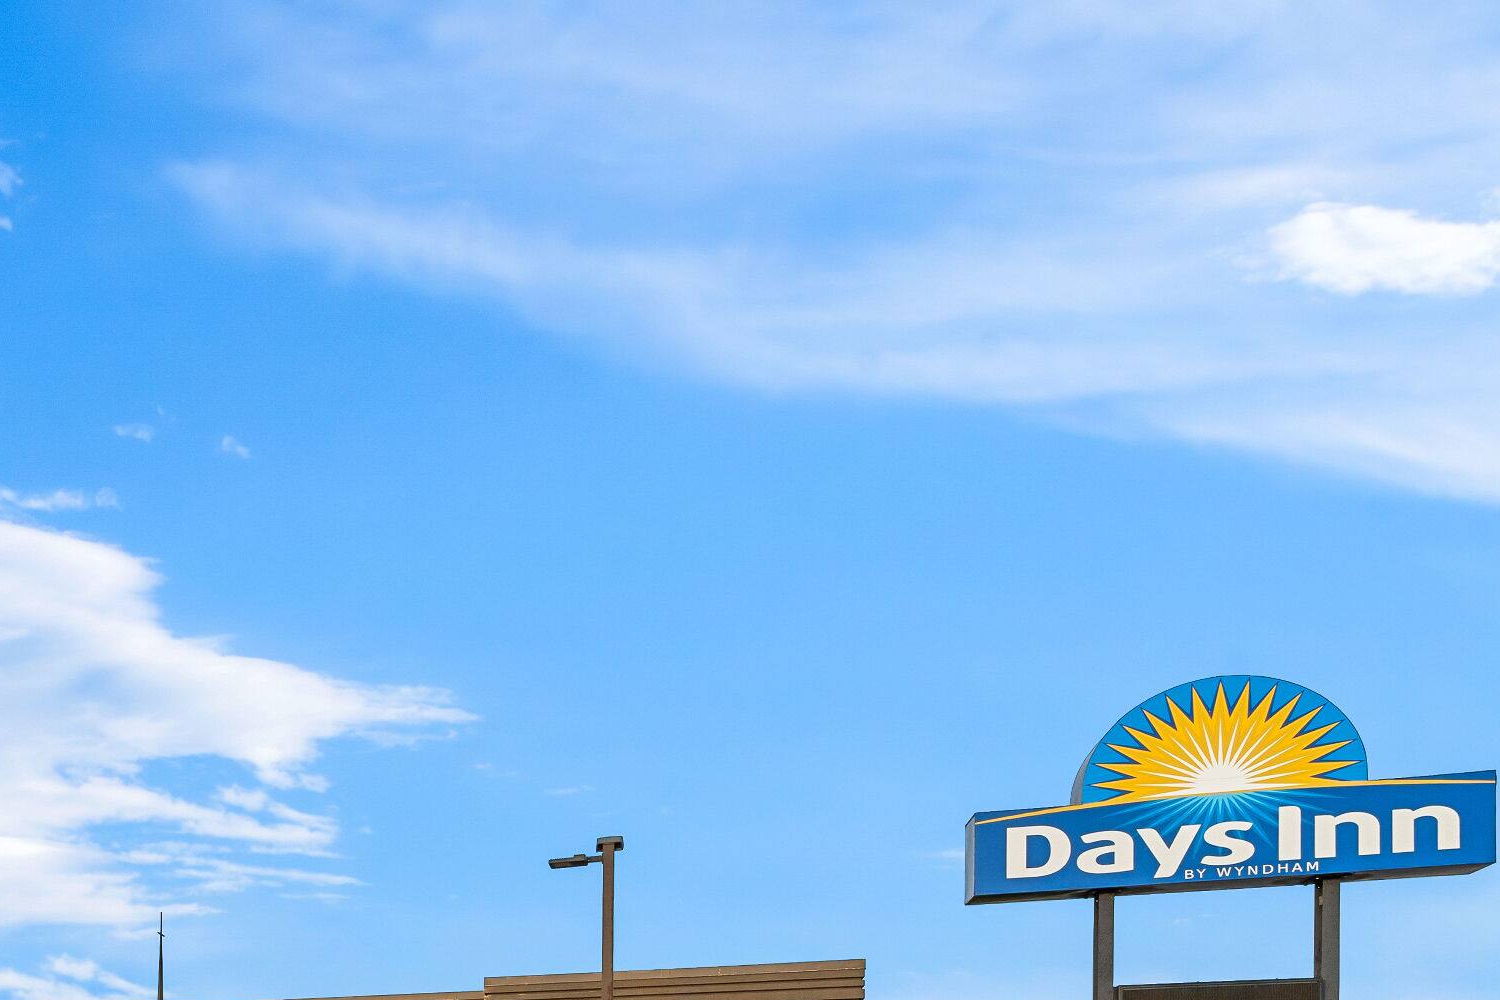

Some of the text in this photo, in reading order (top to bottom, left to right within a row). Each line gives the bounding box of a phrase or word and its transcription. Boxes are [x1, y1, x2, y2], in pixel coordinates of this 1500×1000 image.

[1006, 805, 1461, 879] Days Inn
[1184, 861, 1319, 880] BY WYNDHAM
